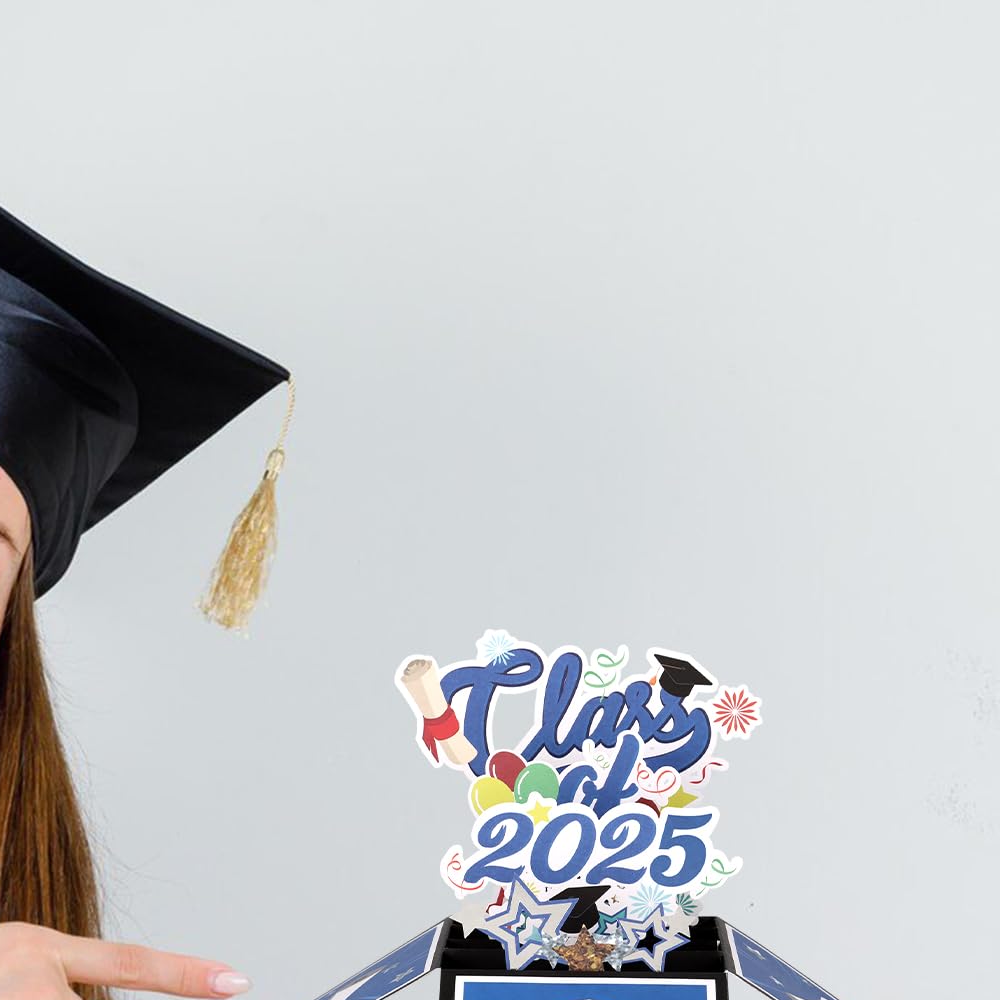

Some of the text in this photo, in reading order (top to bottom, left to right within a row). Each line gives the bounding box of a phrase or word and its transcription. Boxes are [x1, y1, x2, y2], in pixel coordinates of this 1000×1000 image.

[440, 648, 711, 776] Class
[557, 734, 638, 818] of
[463, 812, 712, 887] 2025
